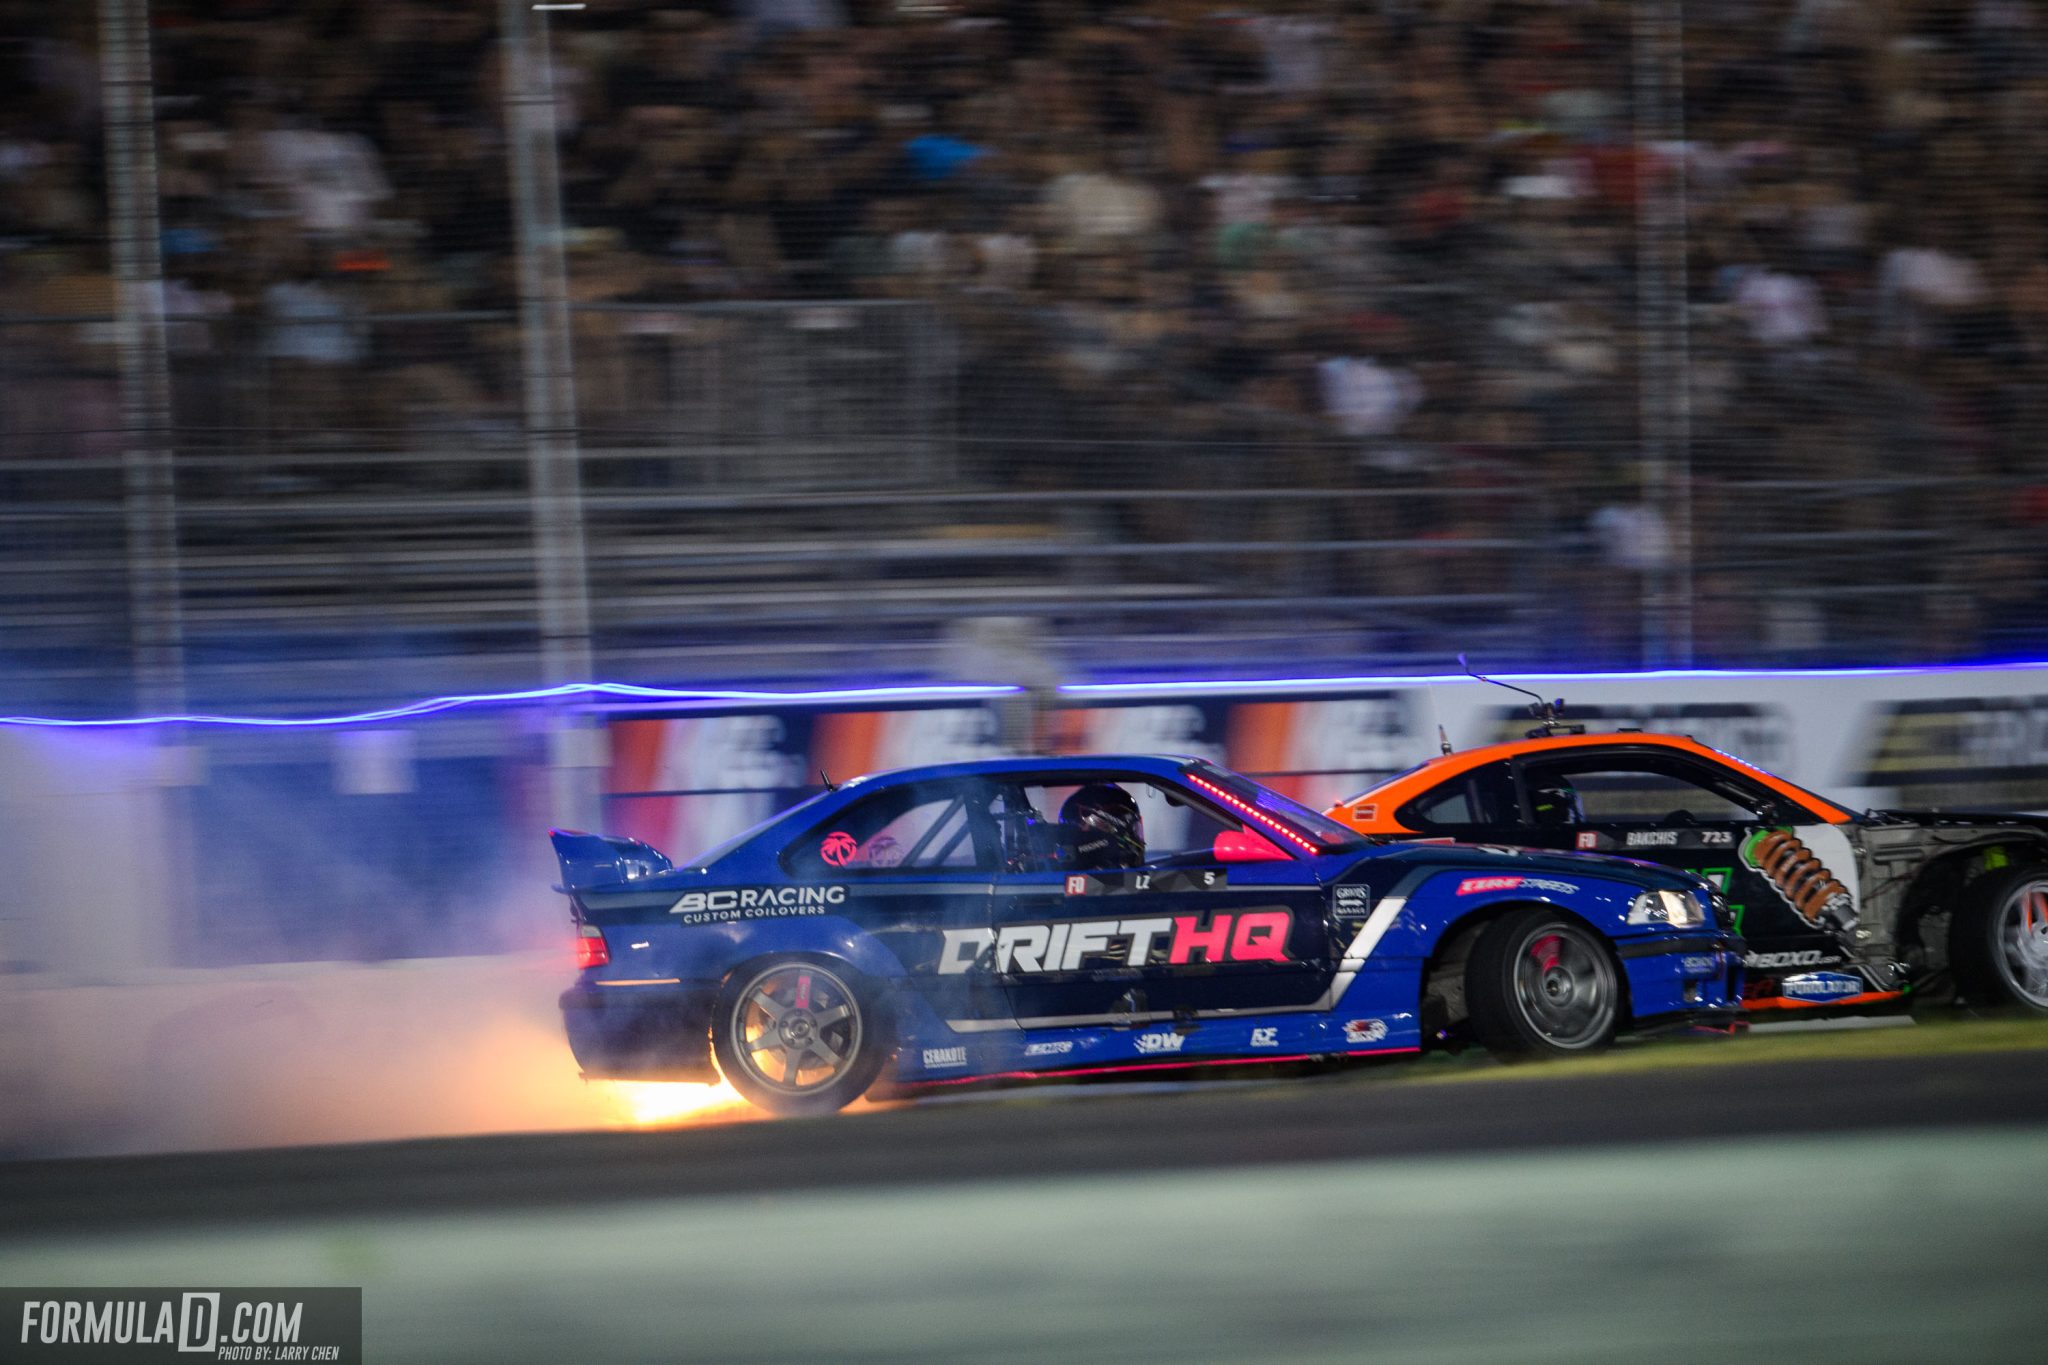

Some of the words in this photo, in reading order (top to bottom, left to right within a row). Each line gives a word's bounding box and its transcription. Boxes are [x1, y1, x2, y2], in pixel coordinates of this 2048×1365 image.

[1701, 831, 1732, 843] 723
[1135, 875, 1150, 890] LZ
[1204, 872, 1215, 885] 5
[740, 885, 845, 907] RACING
[683, 910, 741, 924] CUSTOM
[744, 905, 826, 918] COILOVERS
[1756, 950, 1822, 968] BOXO
